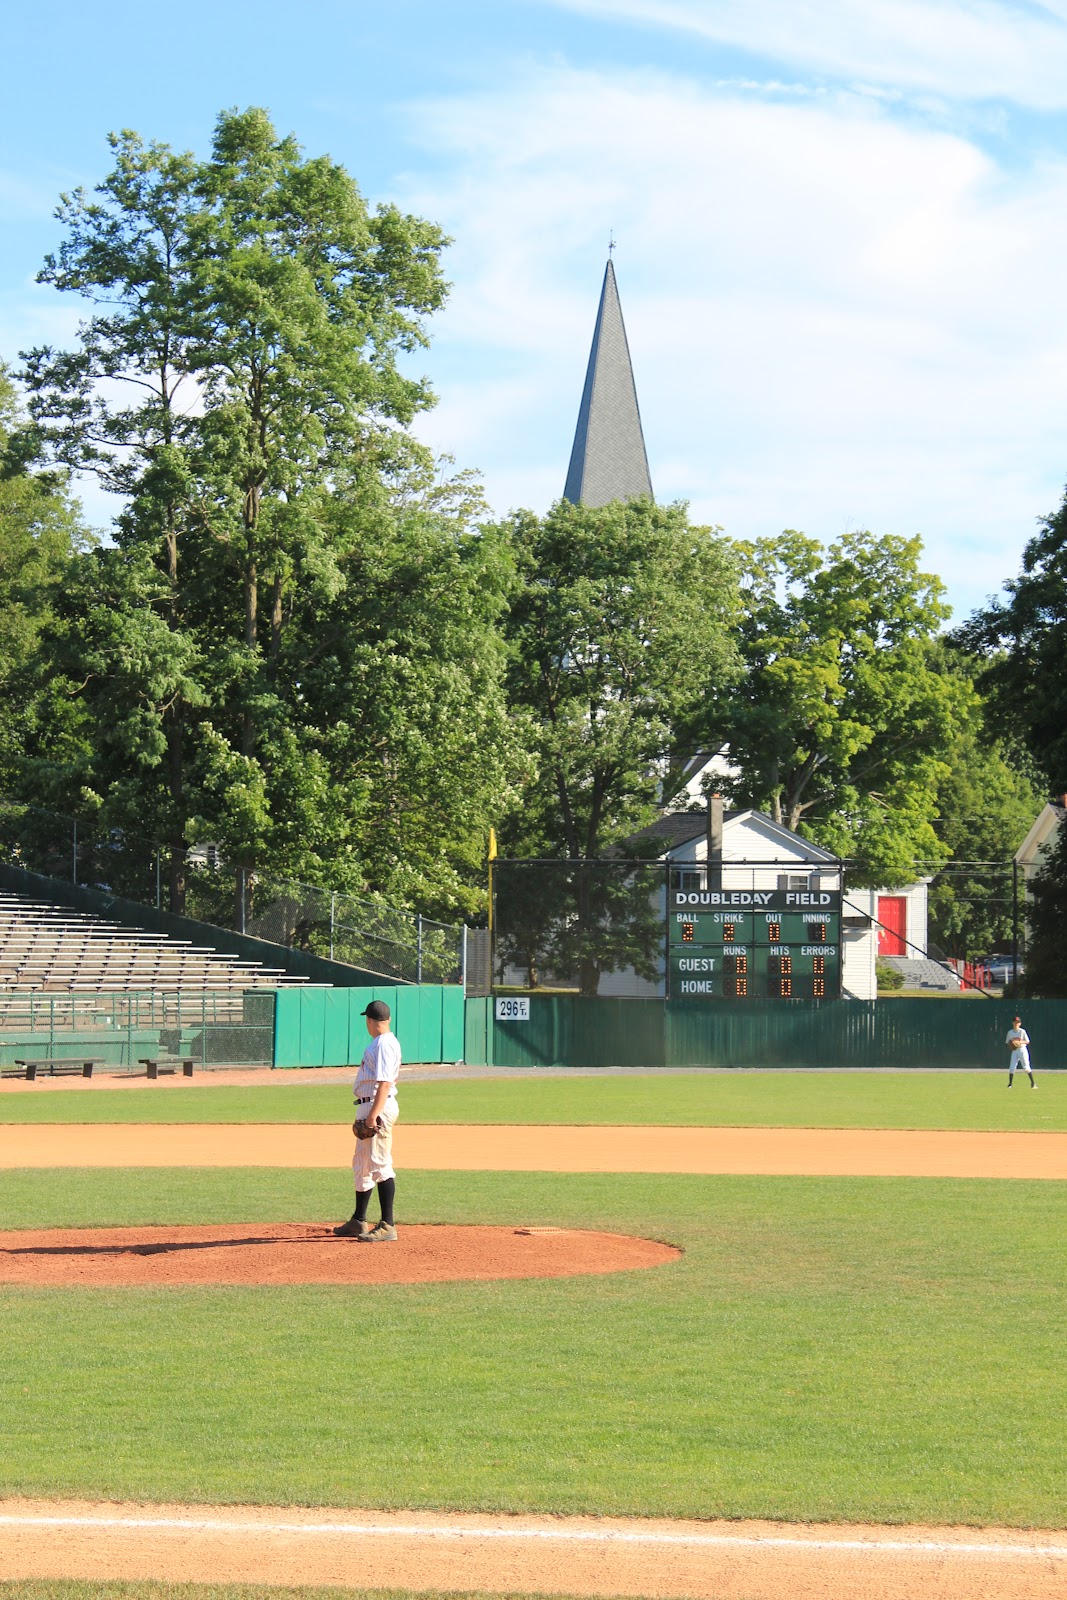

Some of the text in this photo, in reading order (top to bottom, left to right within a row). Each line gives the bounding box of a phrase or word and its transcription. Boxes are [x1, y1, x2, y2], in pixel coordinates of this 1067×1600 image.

[676, 893, 831, 905] DOUBLEDAY FIELD
[676, 912, 831, 923] BALL STRIKE OUT INNING
[683, 924, 693, 941] 2
[723, 924, 734, 941] 2
[769, 924, 780, 941] 0
[723, 946, 836, 956] RUNS HITS ERRORS
[679, 958, 715, 972] GUEST
[736, 957, 747, 974] 0
[781, 957, 792, 974] 0
[681, 980, 713, 993] HOME
[736, 978, 824, 996] 0 0 0
[500, 1001, 518, 1016] 296
